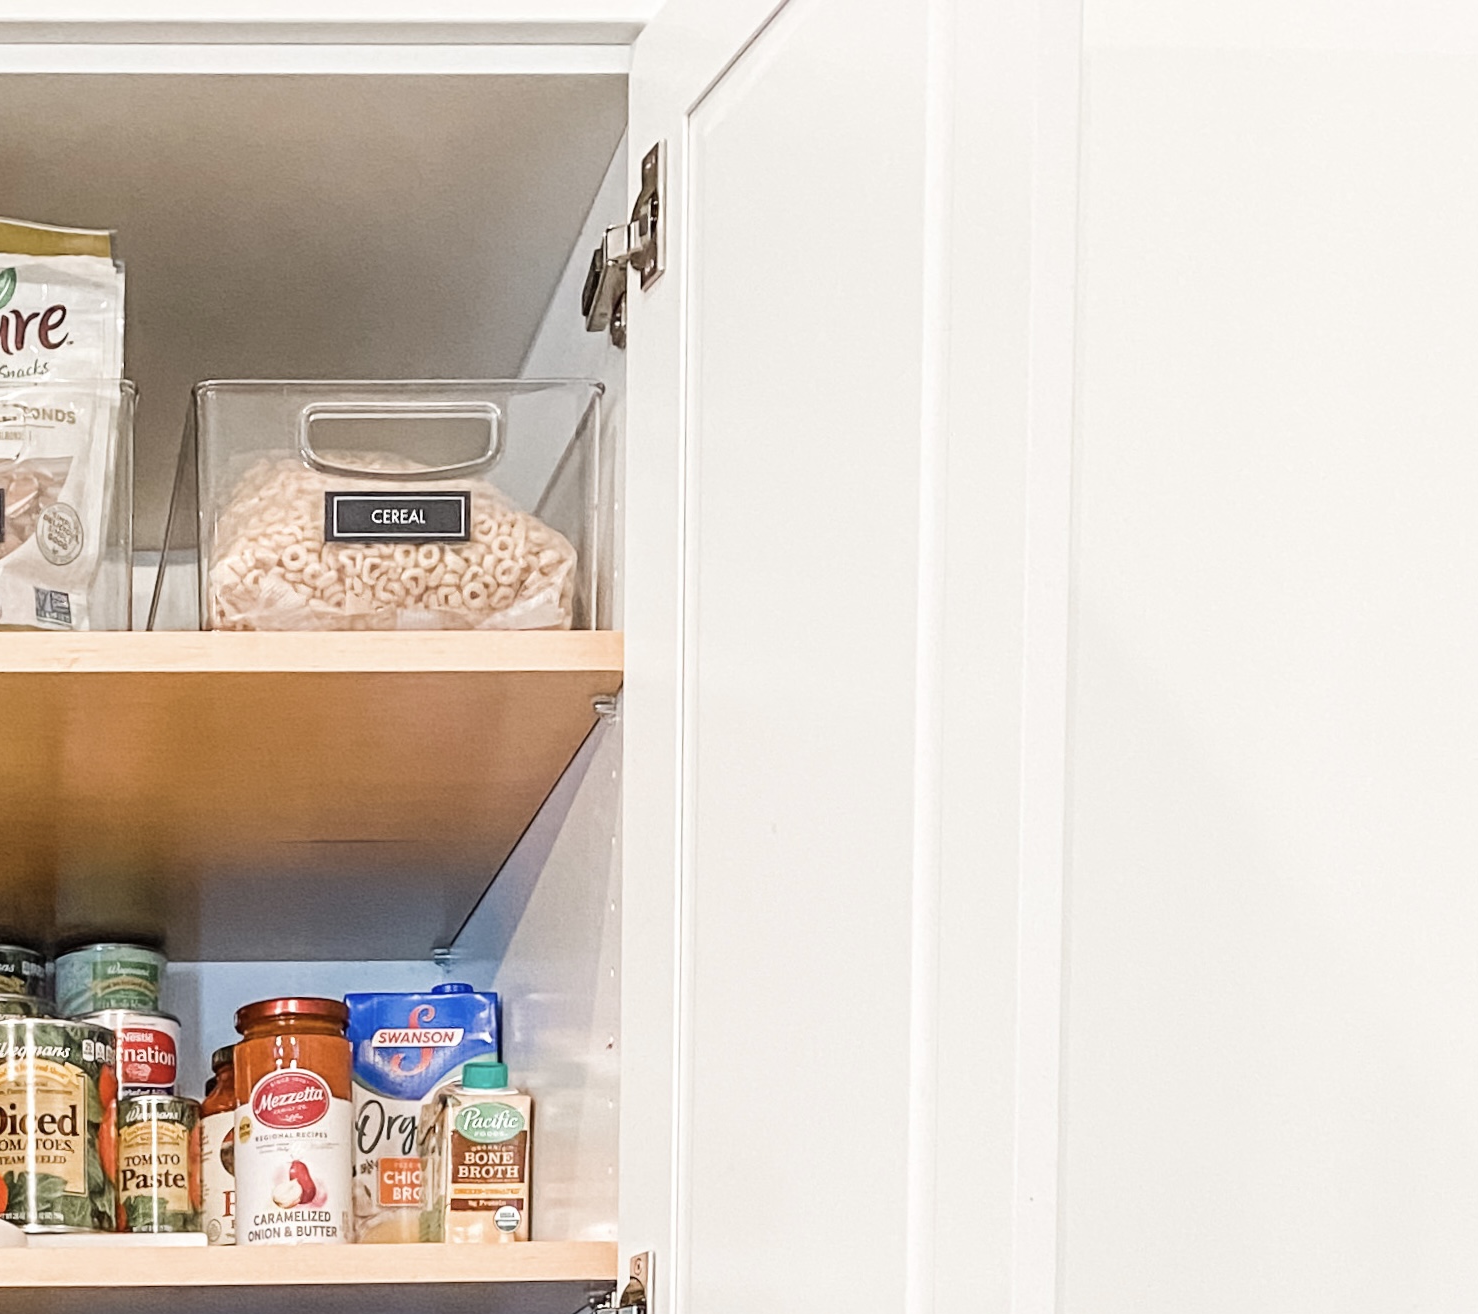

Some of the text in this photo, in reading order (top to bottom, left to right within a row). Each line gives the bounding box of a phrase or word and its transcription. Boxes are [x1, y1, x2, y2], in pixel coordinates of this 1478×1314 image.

[371, 509, 426, 525] CEREAL
[377, 1031, 455, 1045] SWANSON
[254, 1086, 324, 1115] Mezzetta
[461, 1106, 520, 1131] Pacific
[255, 1131, 329, 1143] REGIONAL RECIPES
[464, 1151, 515, 1165] BONE
[120, 1168, 186, 1192] Paste
[457, 1165, 520, 1179] BROTH
[253, 1210, 331, 1227] CARAMELIZED
[247, 1225, 338, 1243] ONION & BUTTER
